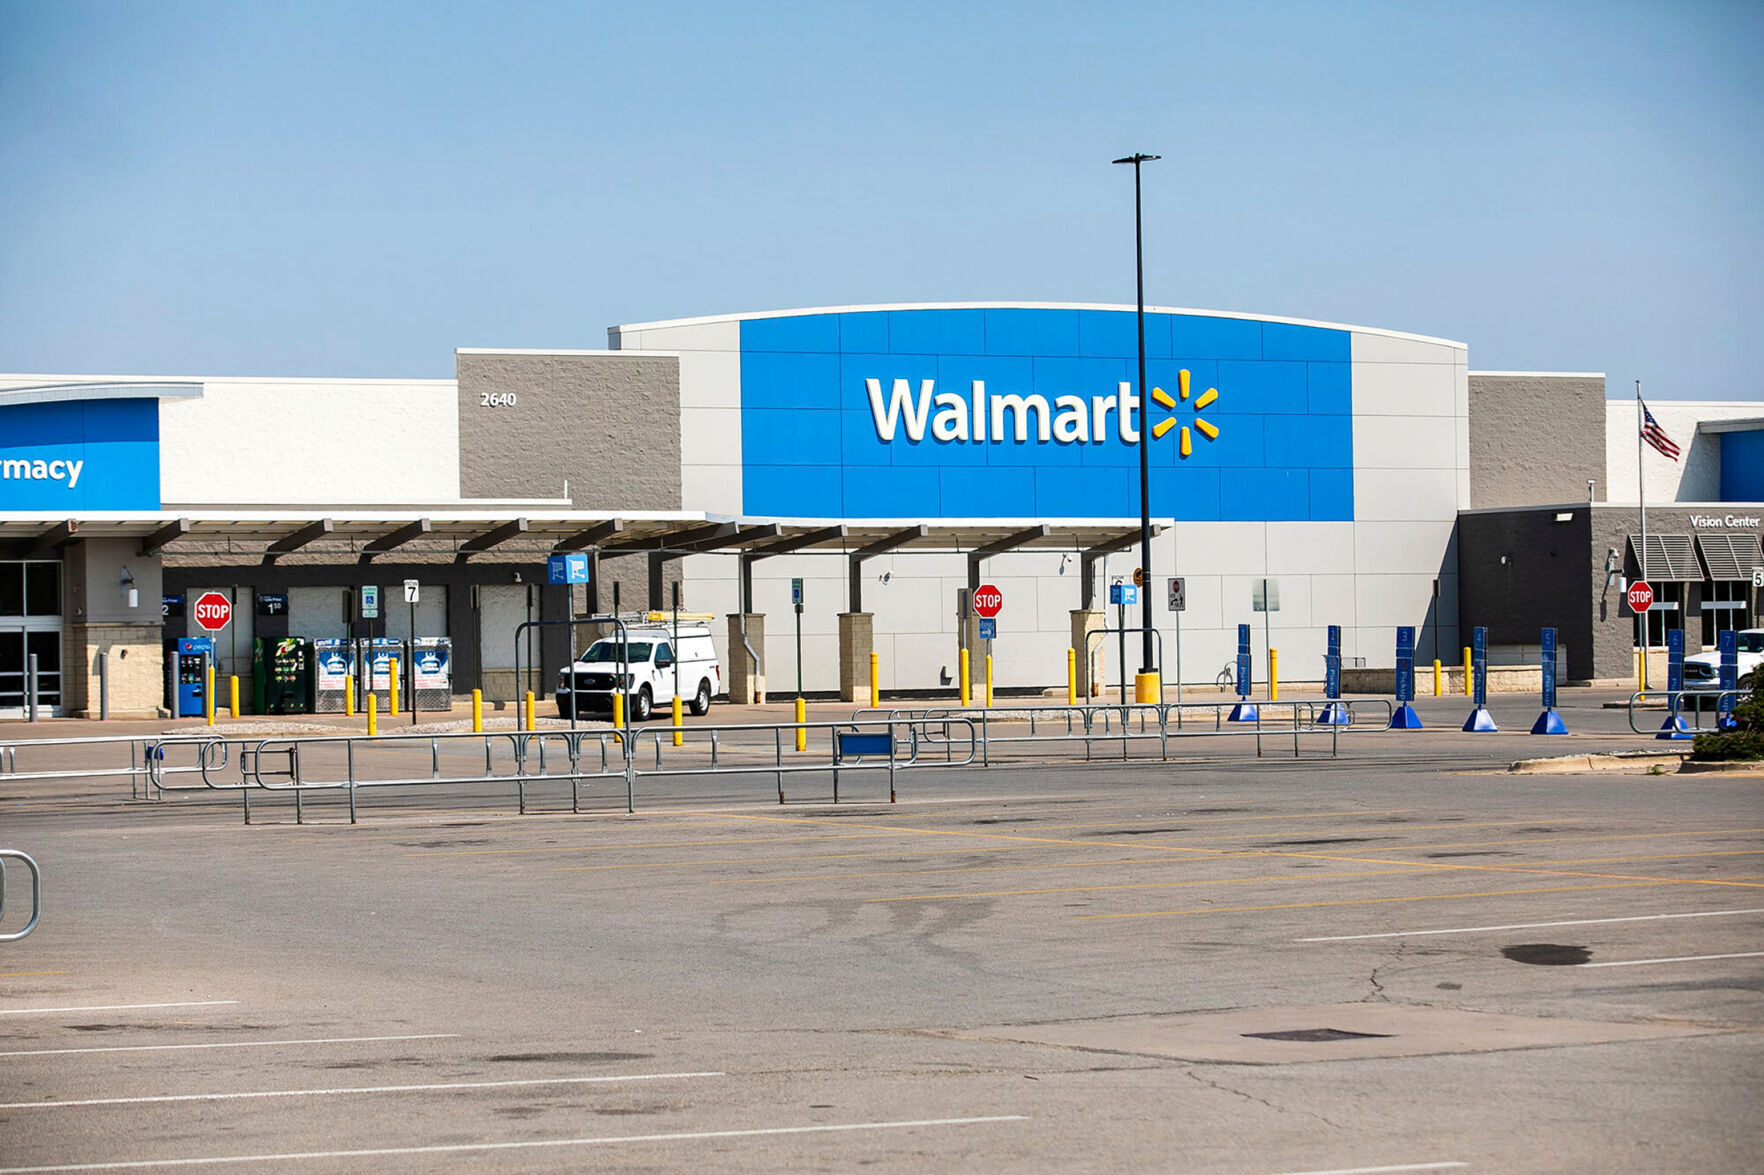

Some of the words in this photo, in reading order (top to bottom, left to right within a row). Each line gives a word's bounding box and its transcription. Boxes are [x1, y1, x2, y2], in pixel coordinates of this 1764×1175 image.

[480, 392, 517, 406] 2640
[865, 378, 1140, 443] Walmart
[0, 459, 84, 488] macy
[1690, 515, 1722, 527] Vision
[1724, 515, 1760, 527] Center
[1755, 573, 1761, 586] 5
[408, 587, 416, 601] 7
[976, 594, 1001, 608] STOP
[1629, 591, 1651, 603] STOP
[198, 604, 229, 619] STOP
[1400, 671, 1408, 700] Pickup
